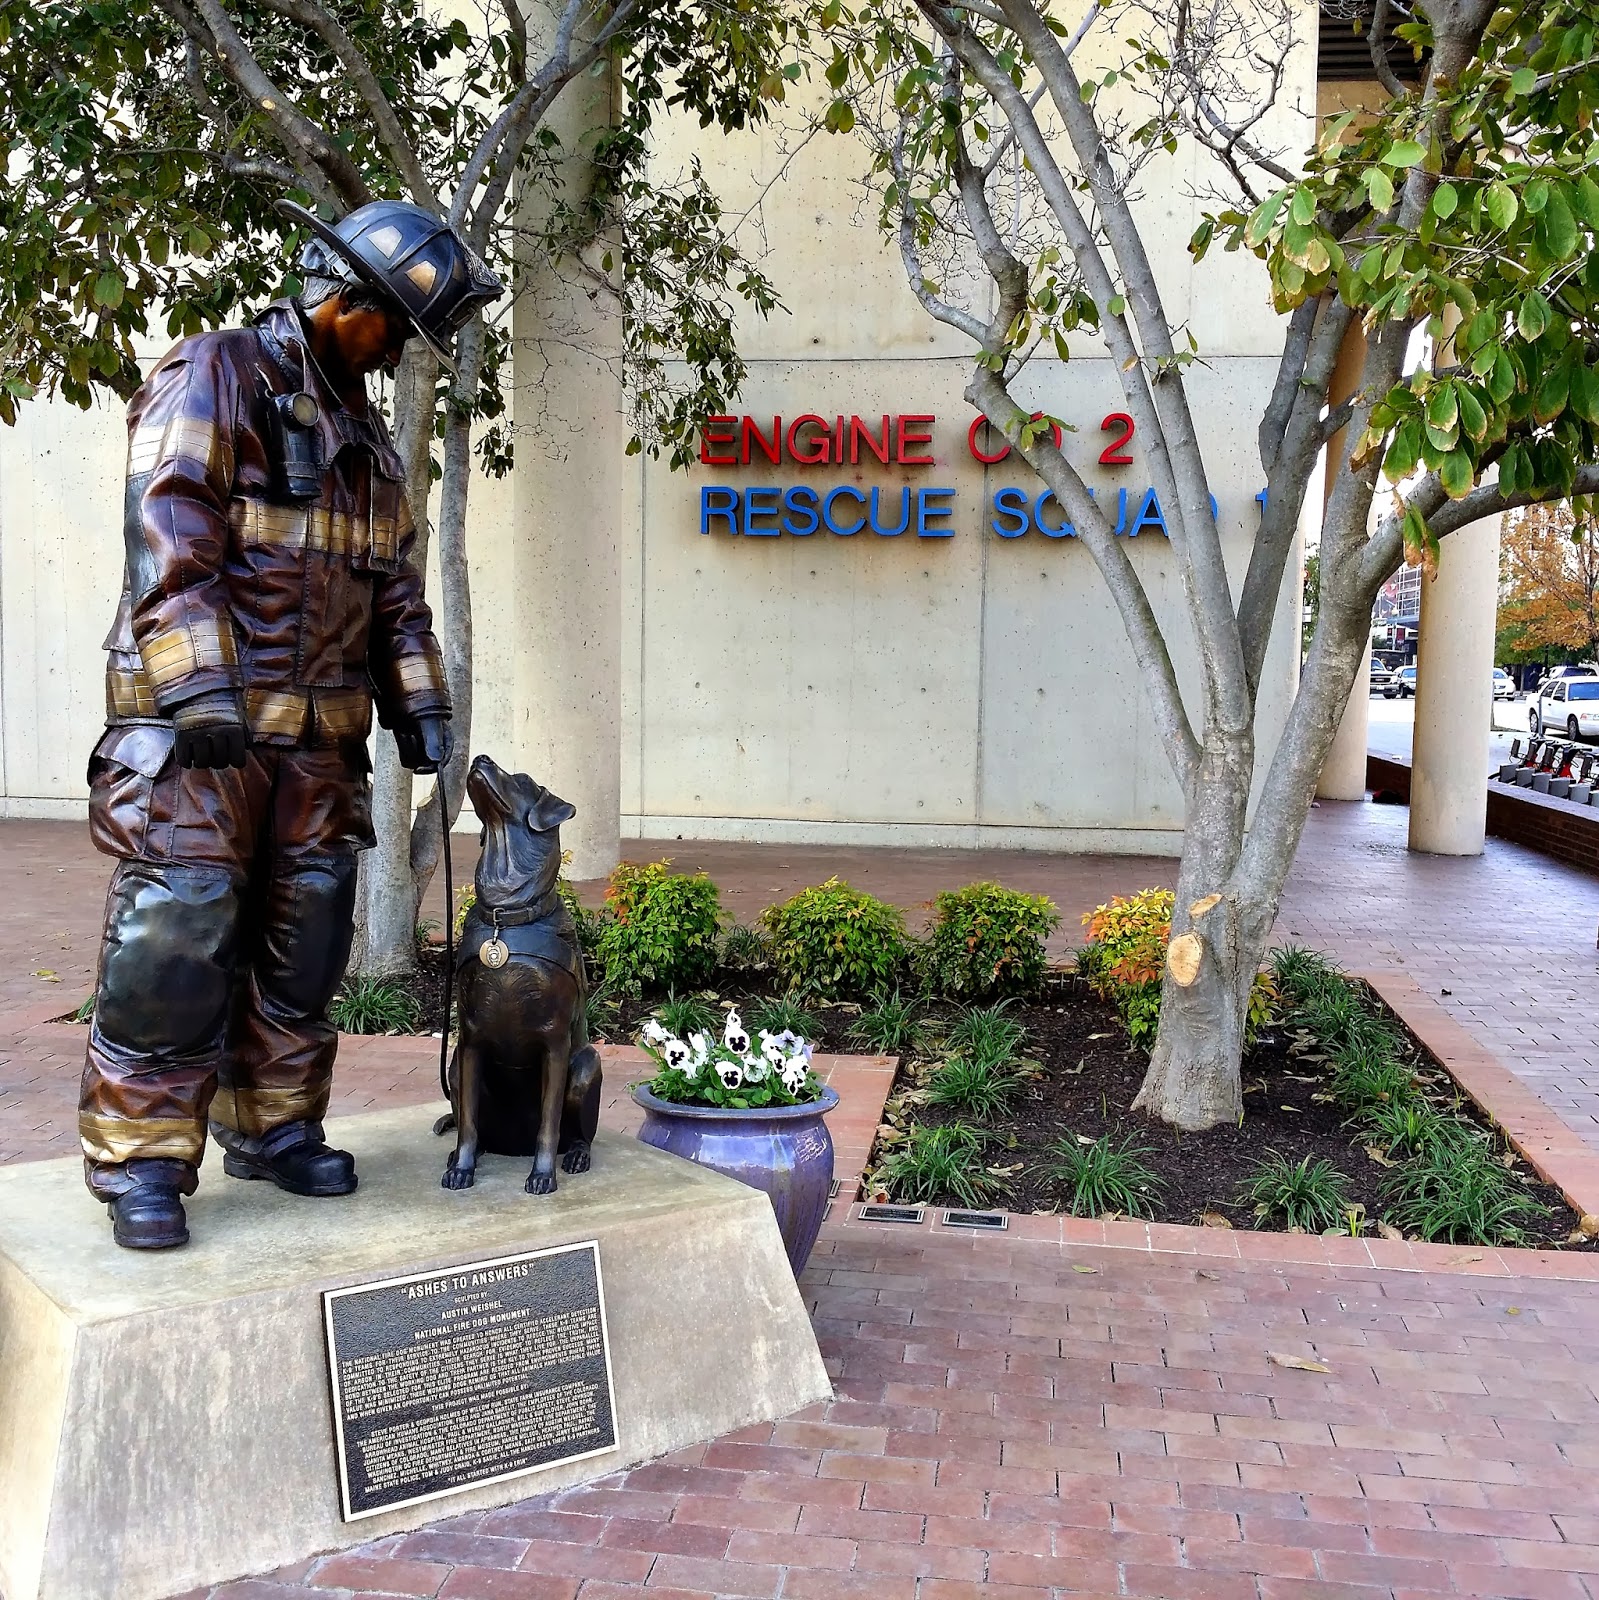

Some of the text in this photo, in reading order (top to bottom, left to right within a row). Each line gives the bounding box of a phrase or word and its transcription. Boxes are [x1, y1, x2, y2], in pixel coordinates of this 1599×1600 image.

[700, 414, 936, 464] ENGINE
[1098, 413, 1135, 464] 2
[700, 485, 956, 537] RESCUE
[992, 487, 1219, 538] SQUA
[401, 1262, 534, 1300] “ASHES TO ANSWERS”
[441, 1299, 502, 1319] AUSTIN WEISHEL
[453, 1292, 479, 1303] SCULPTED
[414, 1308, 530, 1339] NATIONAL FIRE DOG MONUMENT
[431, 1402, 444, 1411] THIS
[444, 1397, 467, 1408] PROJECT
[480, 1391, 495, 1399] MADE
[495, 1385, 519, 1396] POSSIBLE
